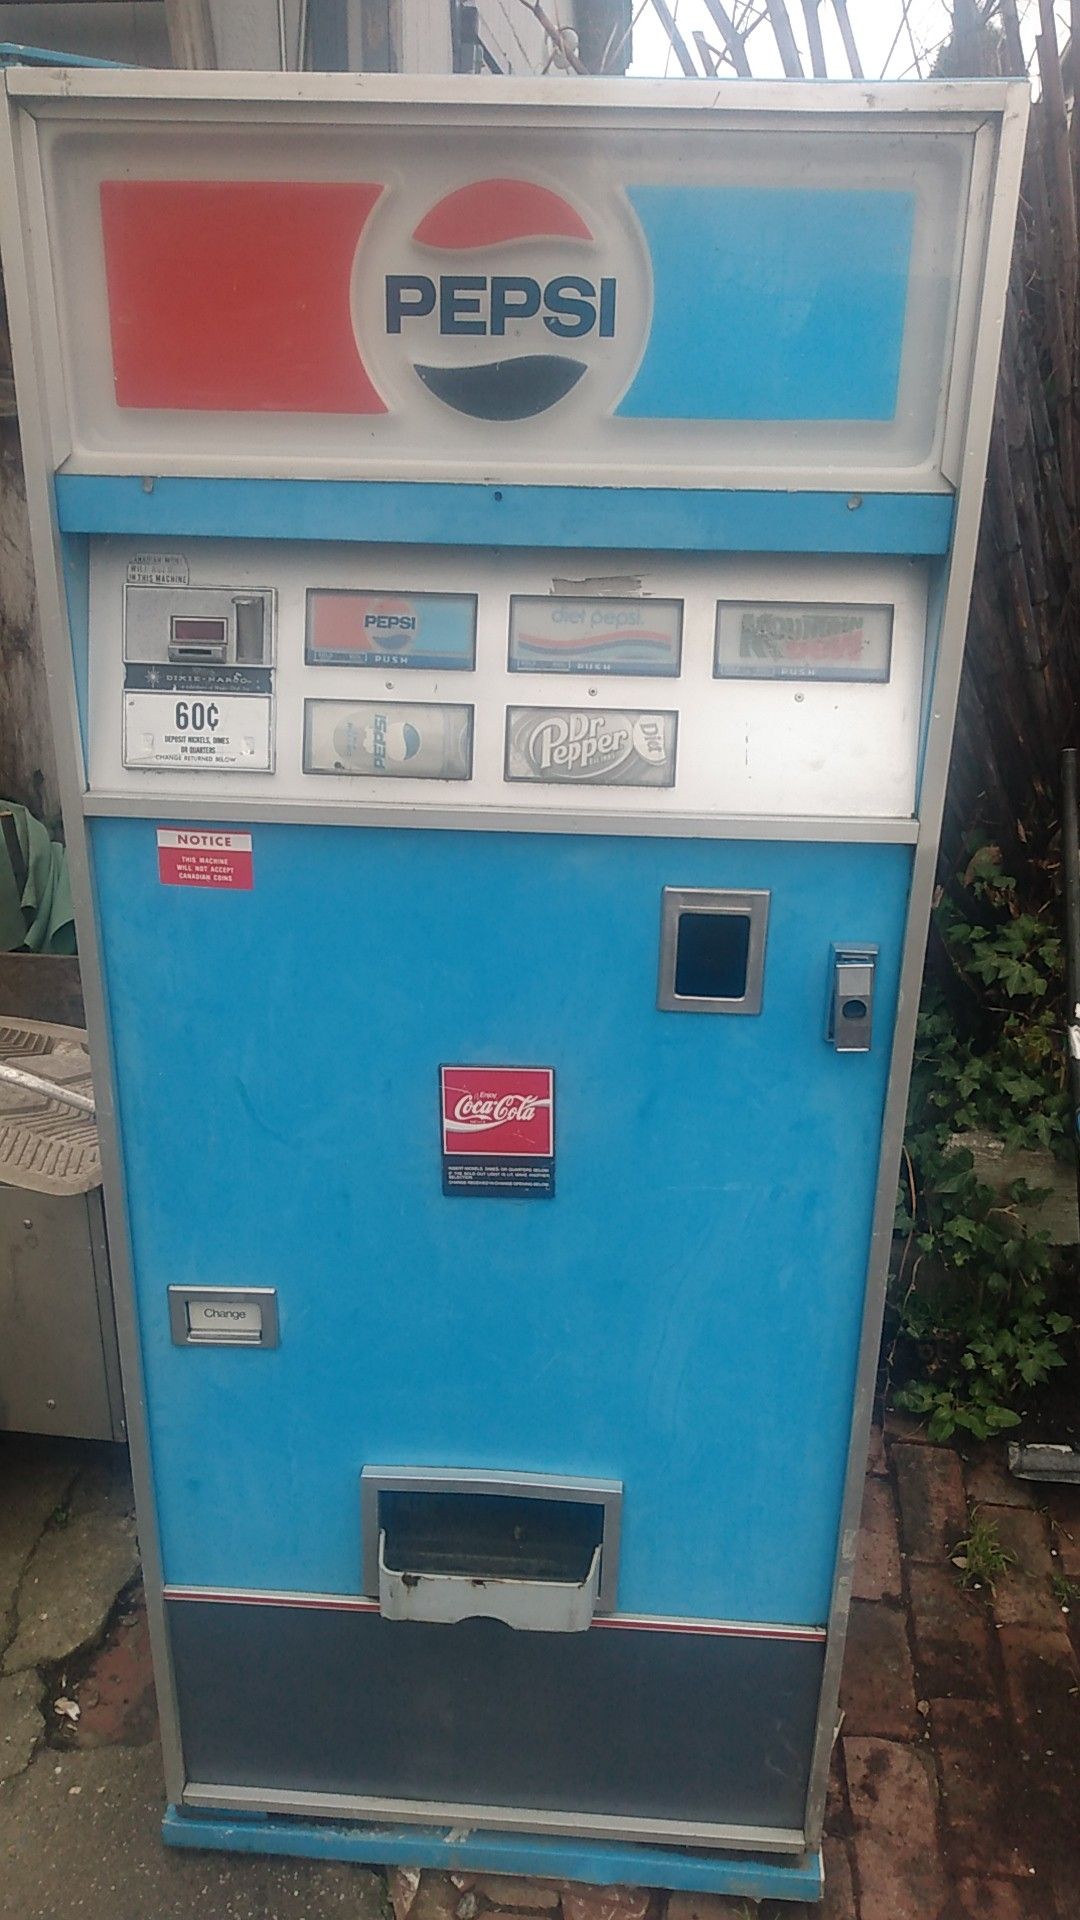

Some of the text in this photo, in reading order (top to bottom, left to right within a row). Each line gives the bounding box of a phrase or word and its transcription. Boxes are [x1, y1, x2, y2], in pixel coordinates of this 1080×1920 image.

[385, 275, 616, 338] PEPSI
[155, 574, 187, 583] MACHINE
[364, 614, 416, 630] PEPSI
[375, 655, 408, 664] PUSH
[781, 668, 815, 676] PUSH
[175, 701, 219, 731] 60¢
[569, 713, 606, 743] Dr
[373, 714, 387, 769] PEPSI
[529, 717, 628, 770] Pepper
[177, 835, 232, 847] NOTICE
[199, 857, 228, 865] MACHINE
[210, 866, 234, 874] ACCEPT
[178, 873, 233, 882] CANADIAN COINS
[480, 1092, 498, 1100] Enjoy
[203, 1308, 246, 1320] Change
